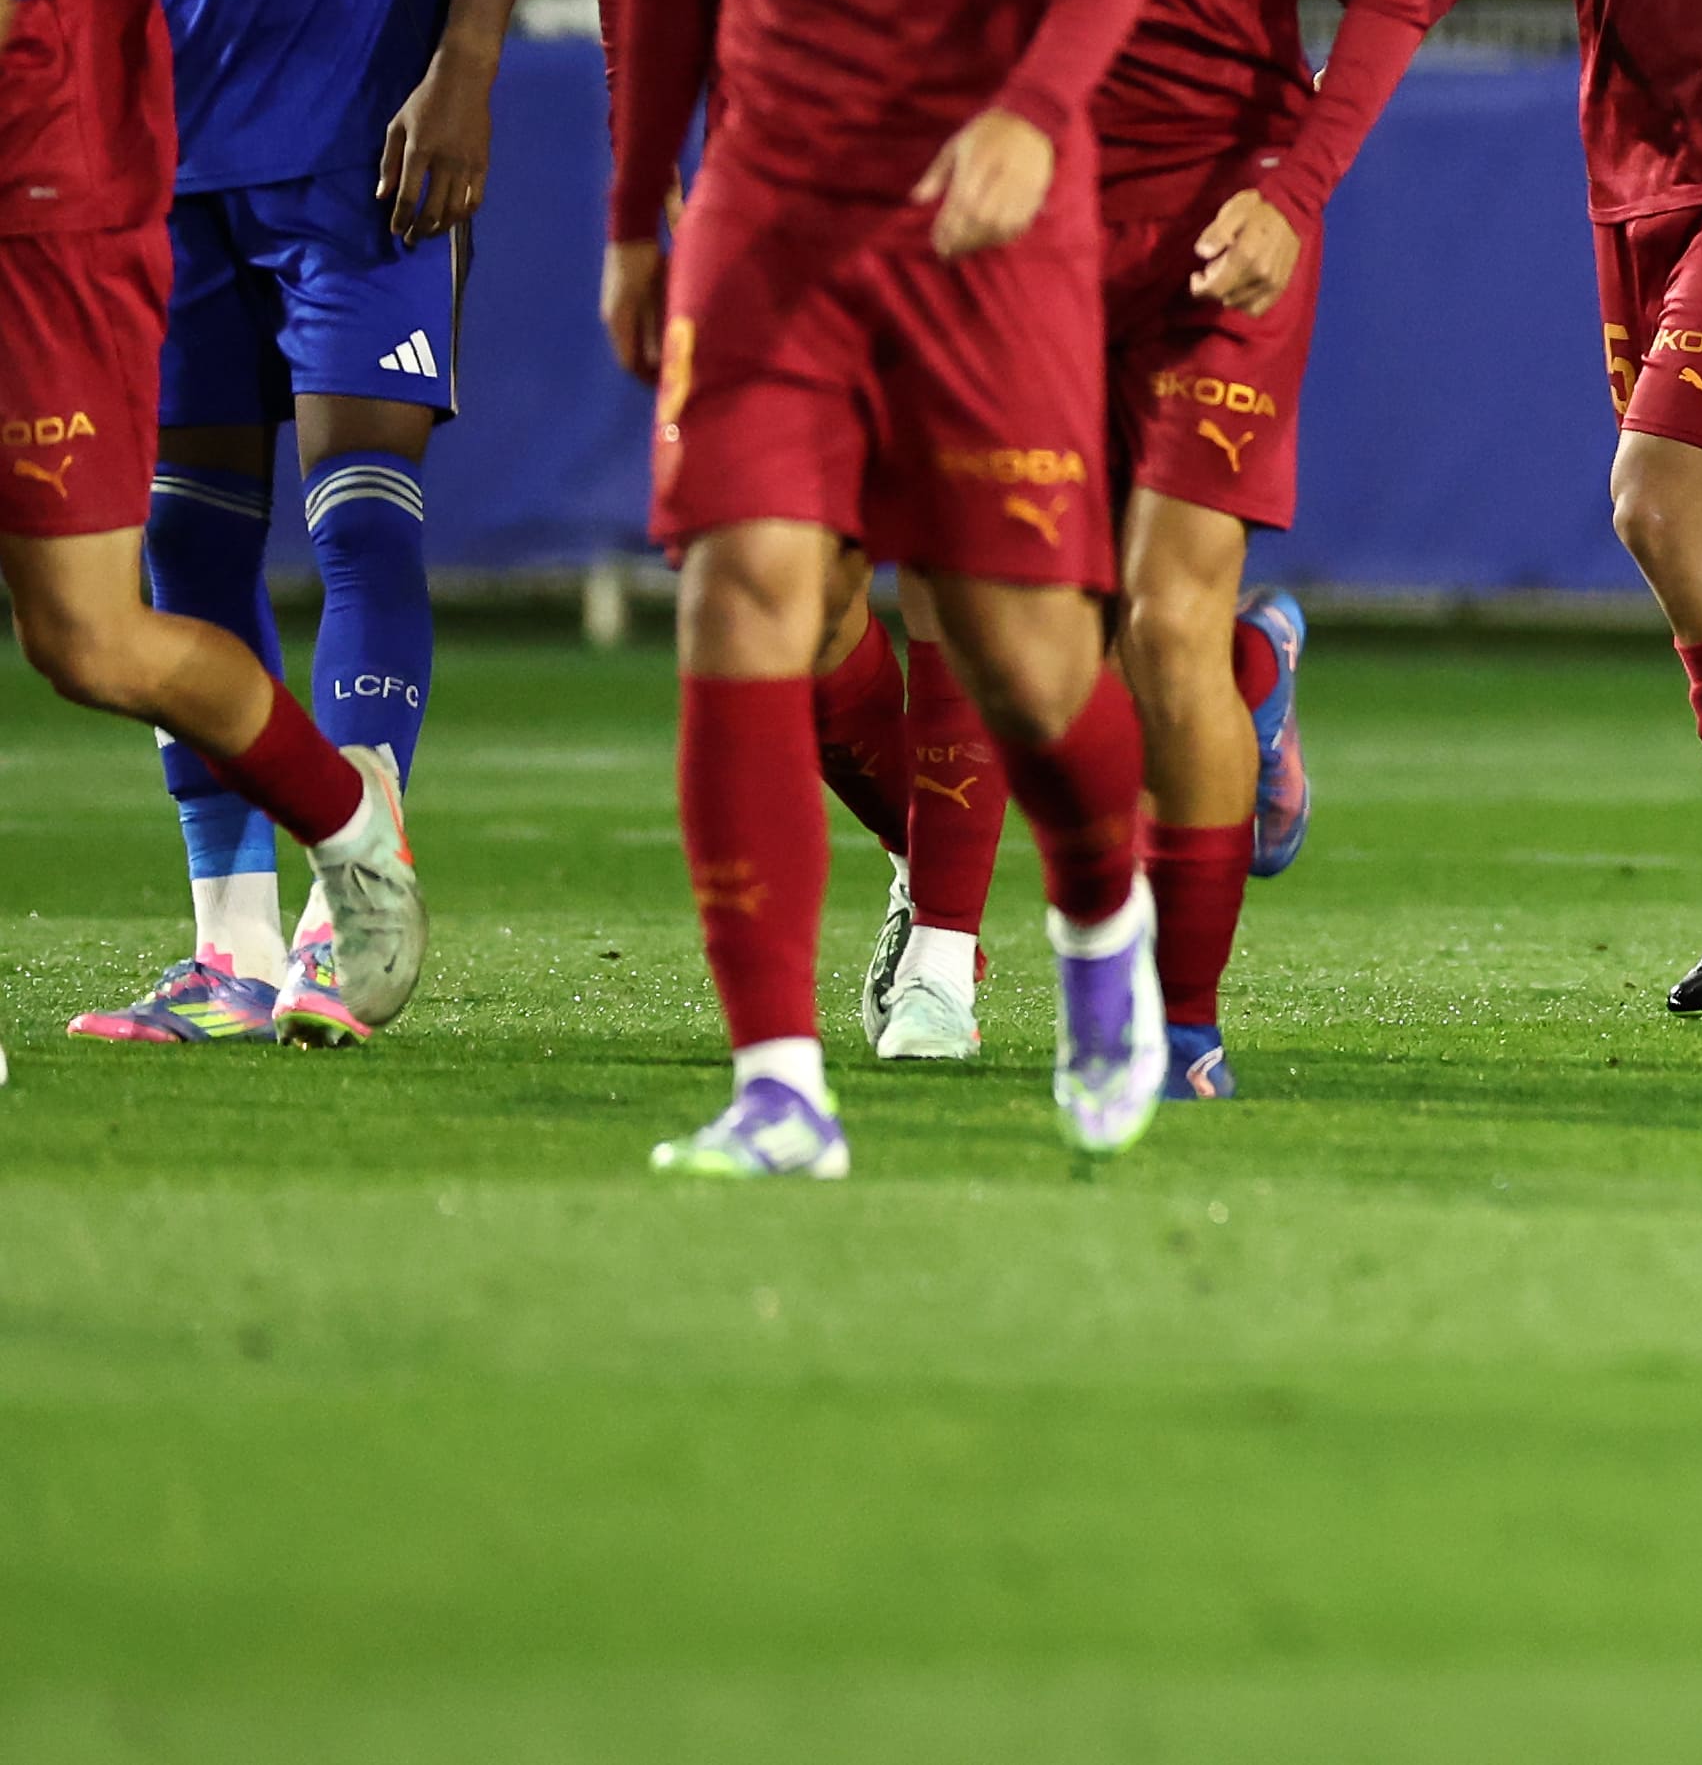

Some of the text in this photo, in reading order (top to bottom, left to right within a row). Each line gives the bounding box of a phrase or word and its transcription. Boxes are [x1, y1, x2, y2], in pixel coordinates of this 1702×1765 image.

[1604, 323, 1636, 415] 5
[2, 411, 97, 446] ODA
[334, 675, 419, 708] LCFC
